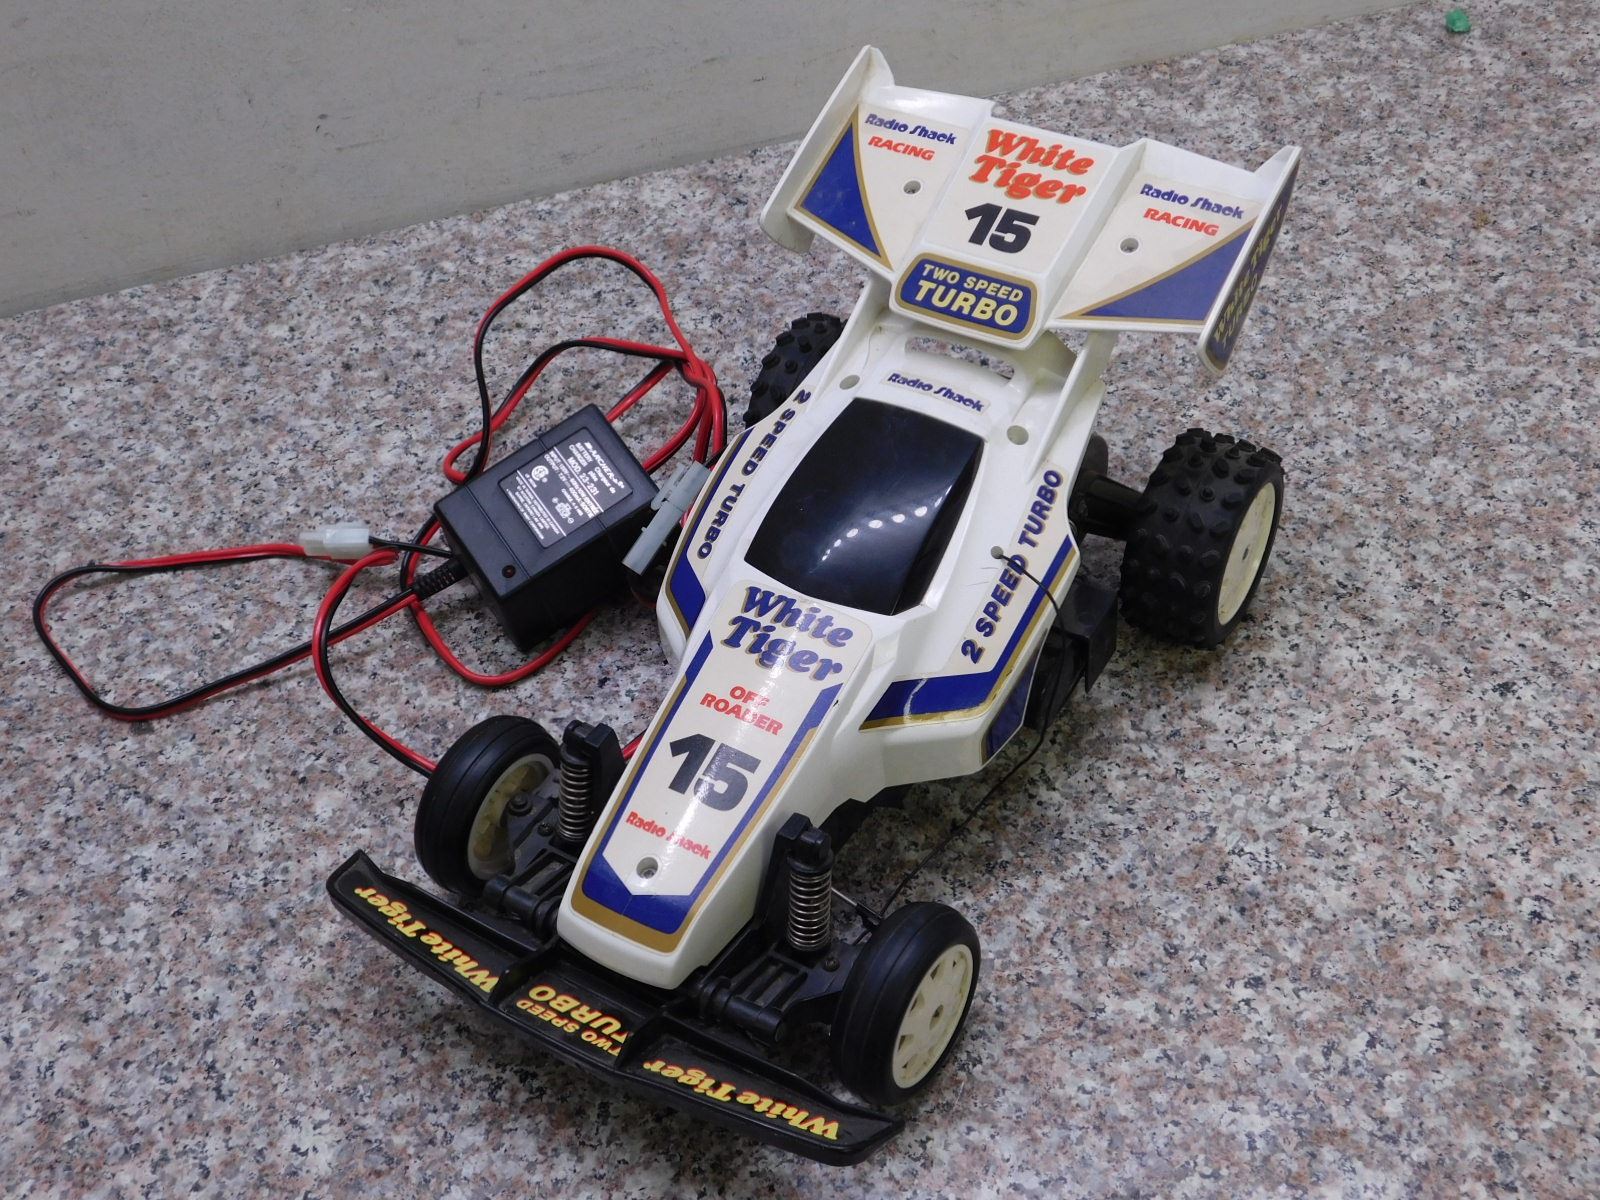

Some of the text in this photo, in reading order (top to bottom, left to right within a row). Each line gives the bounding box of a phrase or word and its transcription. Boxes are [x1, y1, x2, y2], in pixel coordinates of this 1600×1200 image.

[864, 113, 957, 145] Radio Shack
[868, 136, 935, 161] RACING
[984, 128, 1095, 175] White
[968, 154, 1088, 204] Tiger
[1140, 183, 1245, 219] Radio Shack
[965, 203, 1040, 253] 15
[1143, 207, 1219, 236] RACING
[914, 280, 1018, 326] TURBO
[923, 263, 1024, 302] TWO SPEED
[887, 373, 984, 412] Radio Shack
[697, 389, 811, 559] 2 SPEED TURBO
[961, 470, 1063, 664] 2 SPEED TURBO
[741, 586, 853, 647] White
[721, 616, 842, 680] Tiger
[669, 733, 761, 812] 15
[625, 811, 711, 860] Radio Sack
[354, 888, 499, 992] White Tiger
[516, 1000, 580, 1033] SPEED
[643, 1059, 840, 1140] White Tiger
